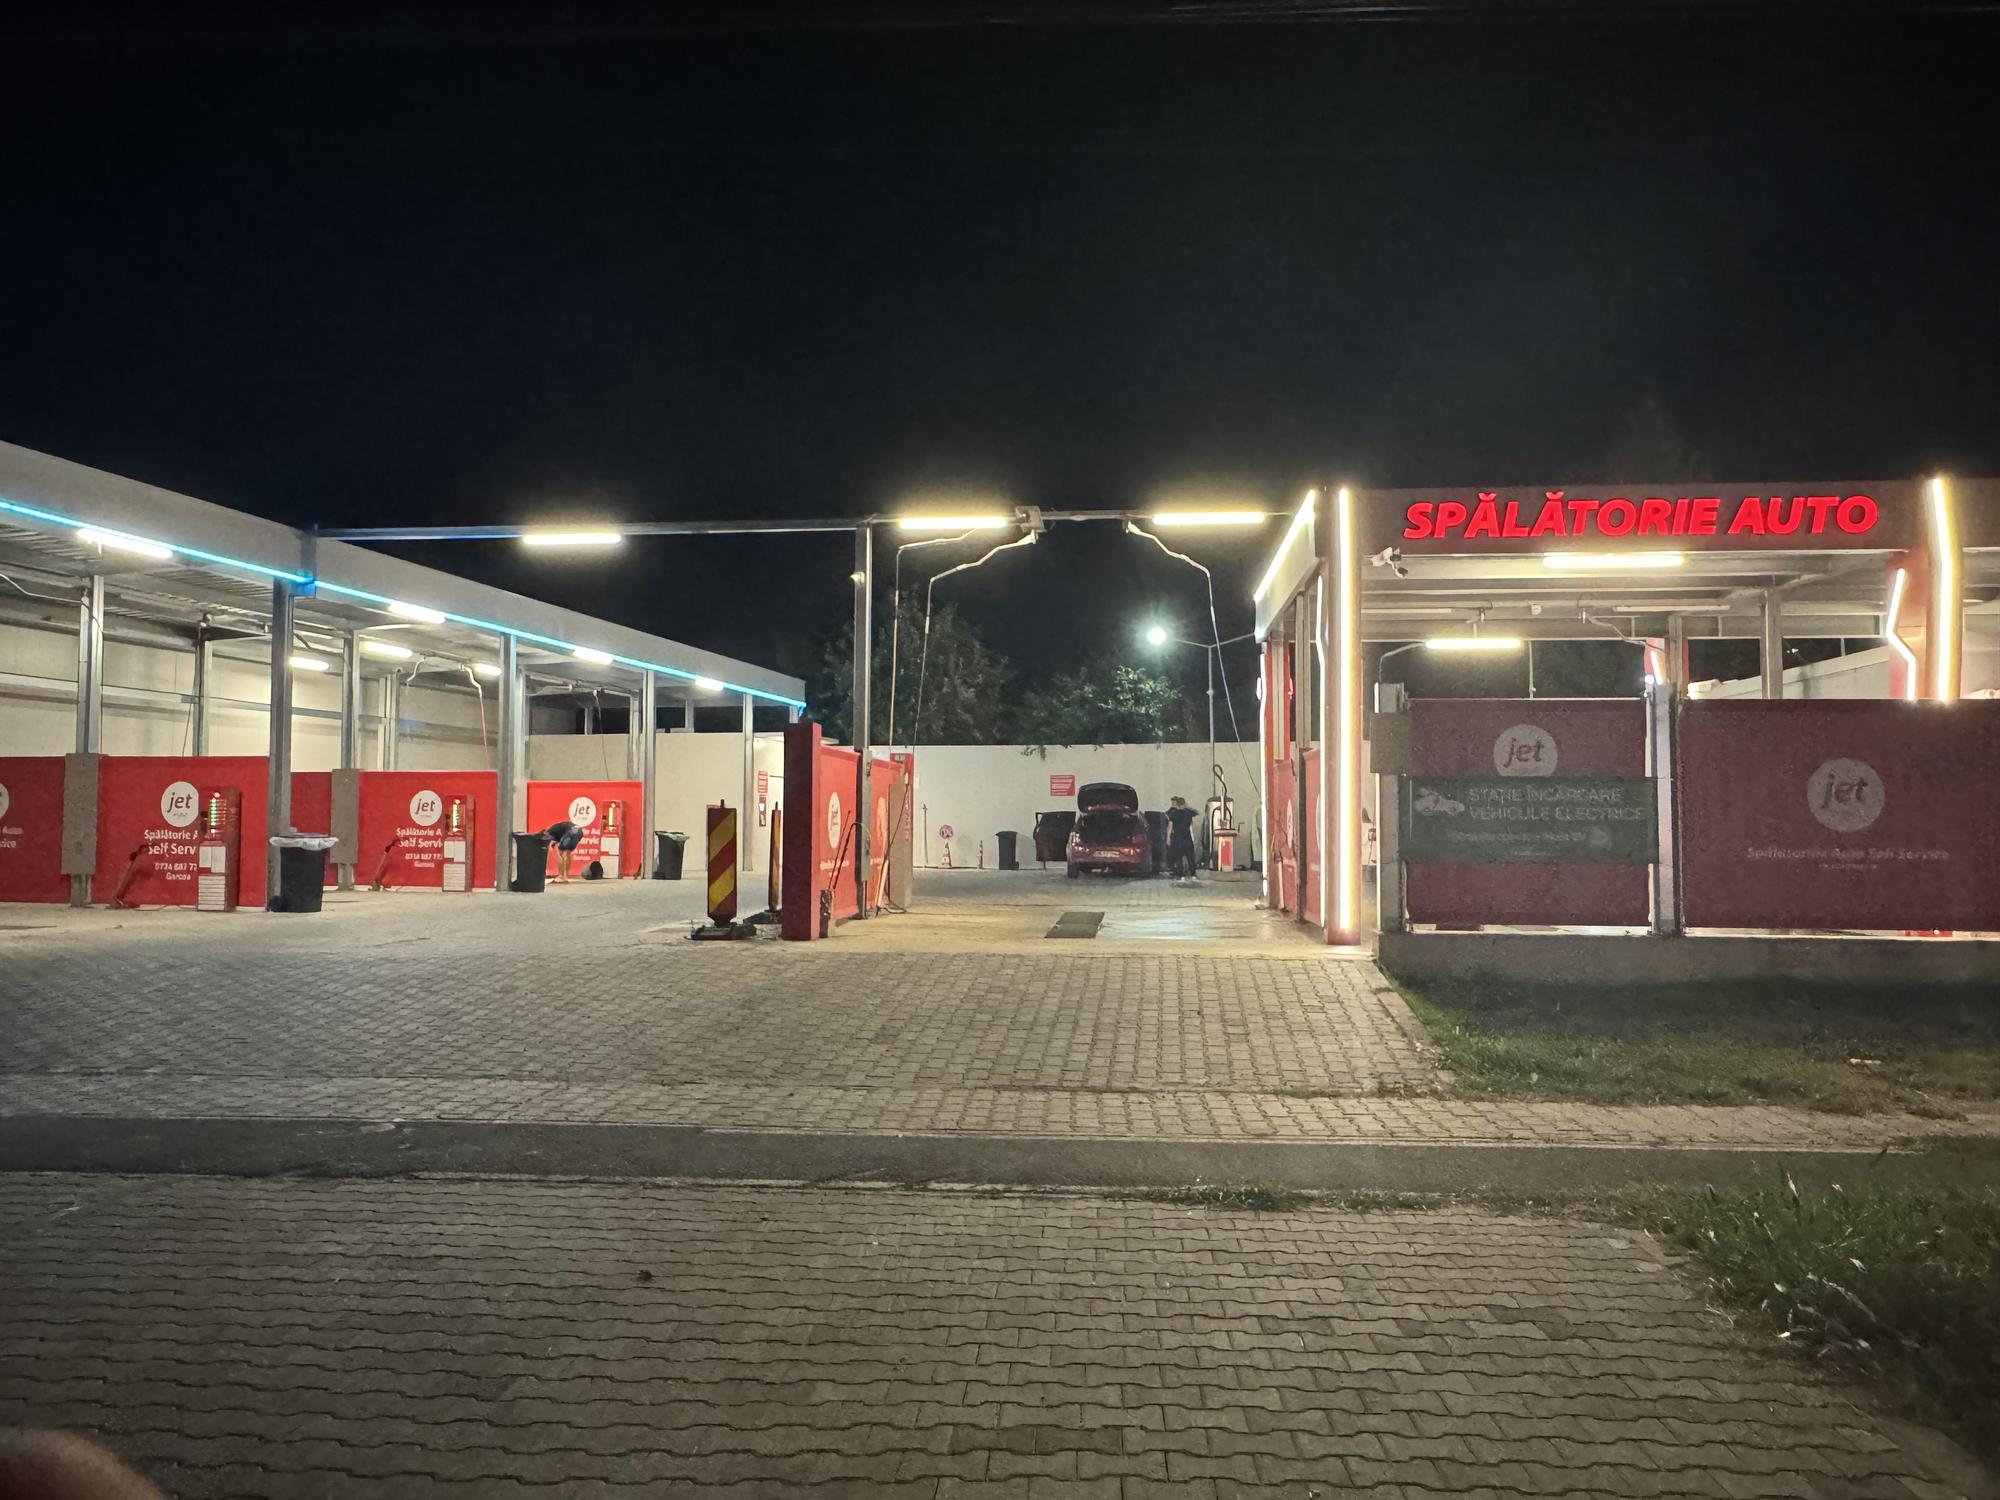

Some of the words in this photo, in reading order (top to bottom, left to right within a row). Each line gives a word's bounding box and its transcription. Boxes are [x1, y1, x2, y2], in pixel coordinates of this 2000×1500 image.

[1404, 492, 1720, 539] SPĂLĂTORIE
[1728, 495, 1879, 536] AUTO
[1504, 737, 1545, 768] jet
[1821, 771, 1868, 809] jet
[167, 792, 192, 813] jet
[415, 798, 435, 815] jet
[574, 803, 590, 817] jet
[1470, 806, 1549, 821] VEHICULE
[1555, 806, 1647, 821] ELECTRICE
[171, 843, 196, 855] Serv
